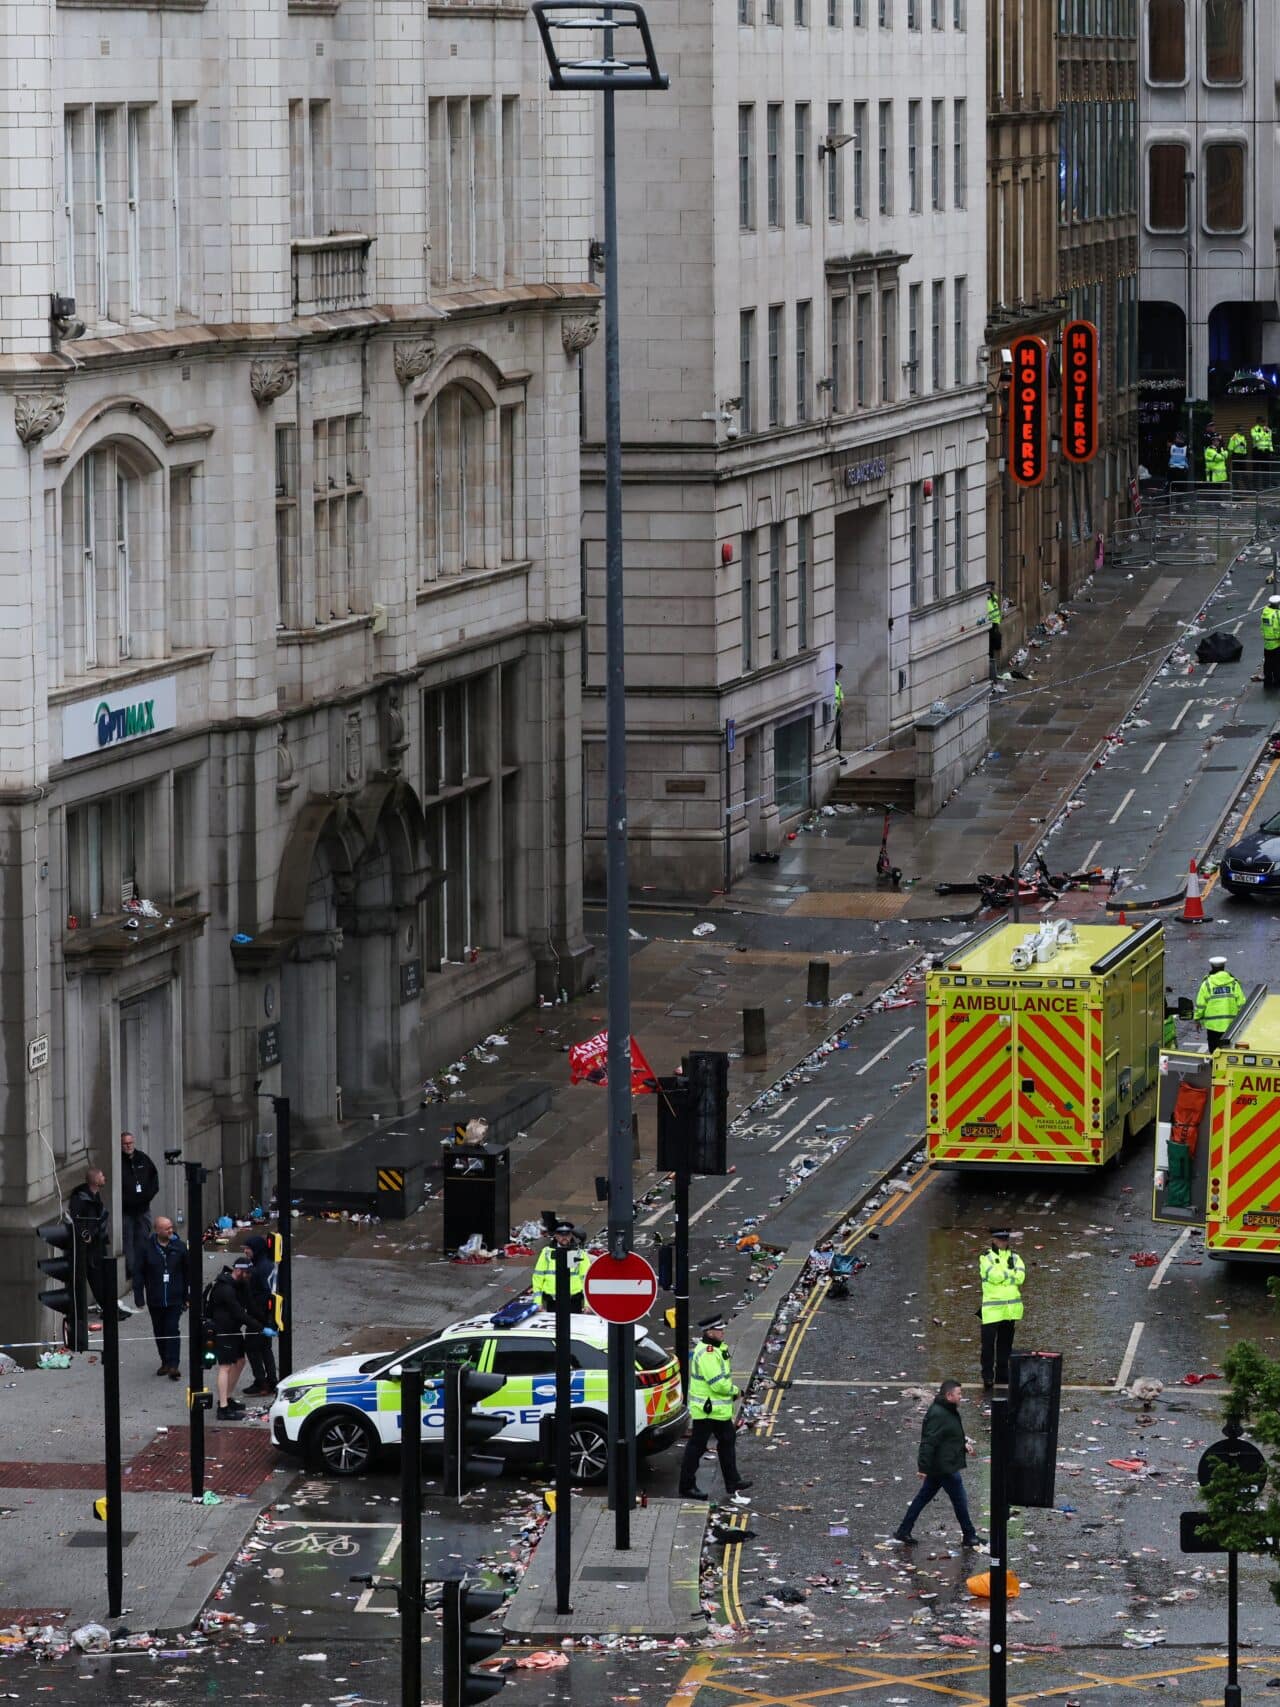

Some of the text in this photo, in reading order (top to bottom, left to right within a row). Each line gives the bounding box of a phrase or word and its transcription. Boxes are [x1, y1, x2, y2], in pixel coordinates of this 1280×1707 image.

[1072, 333, 1087, 454] HOOTERS
[1021, 349, 1036, 477] HOOTERS
[94, 699, 155, 746] OPTIMAX
[953, 995, 1078, 1013] AMBULANCE
[32, 1041, 46, 1054] WATER
[32, 1052, 46, 1065] STREET
